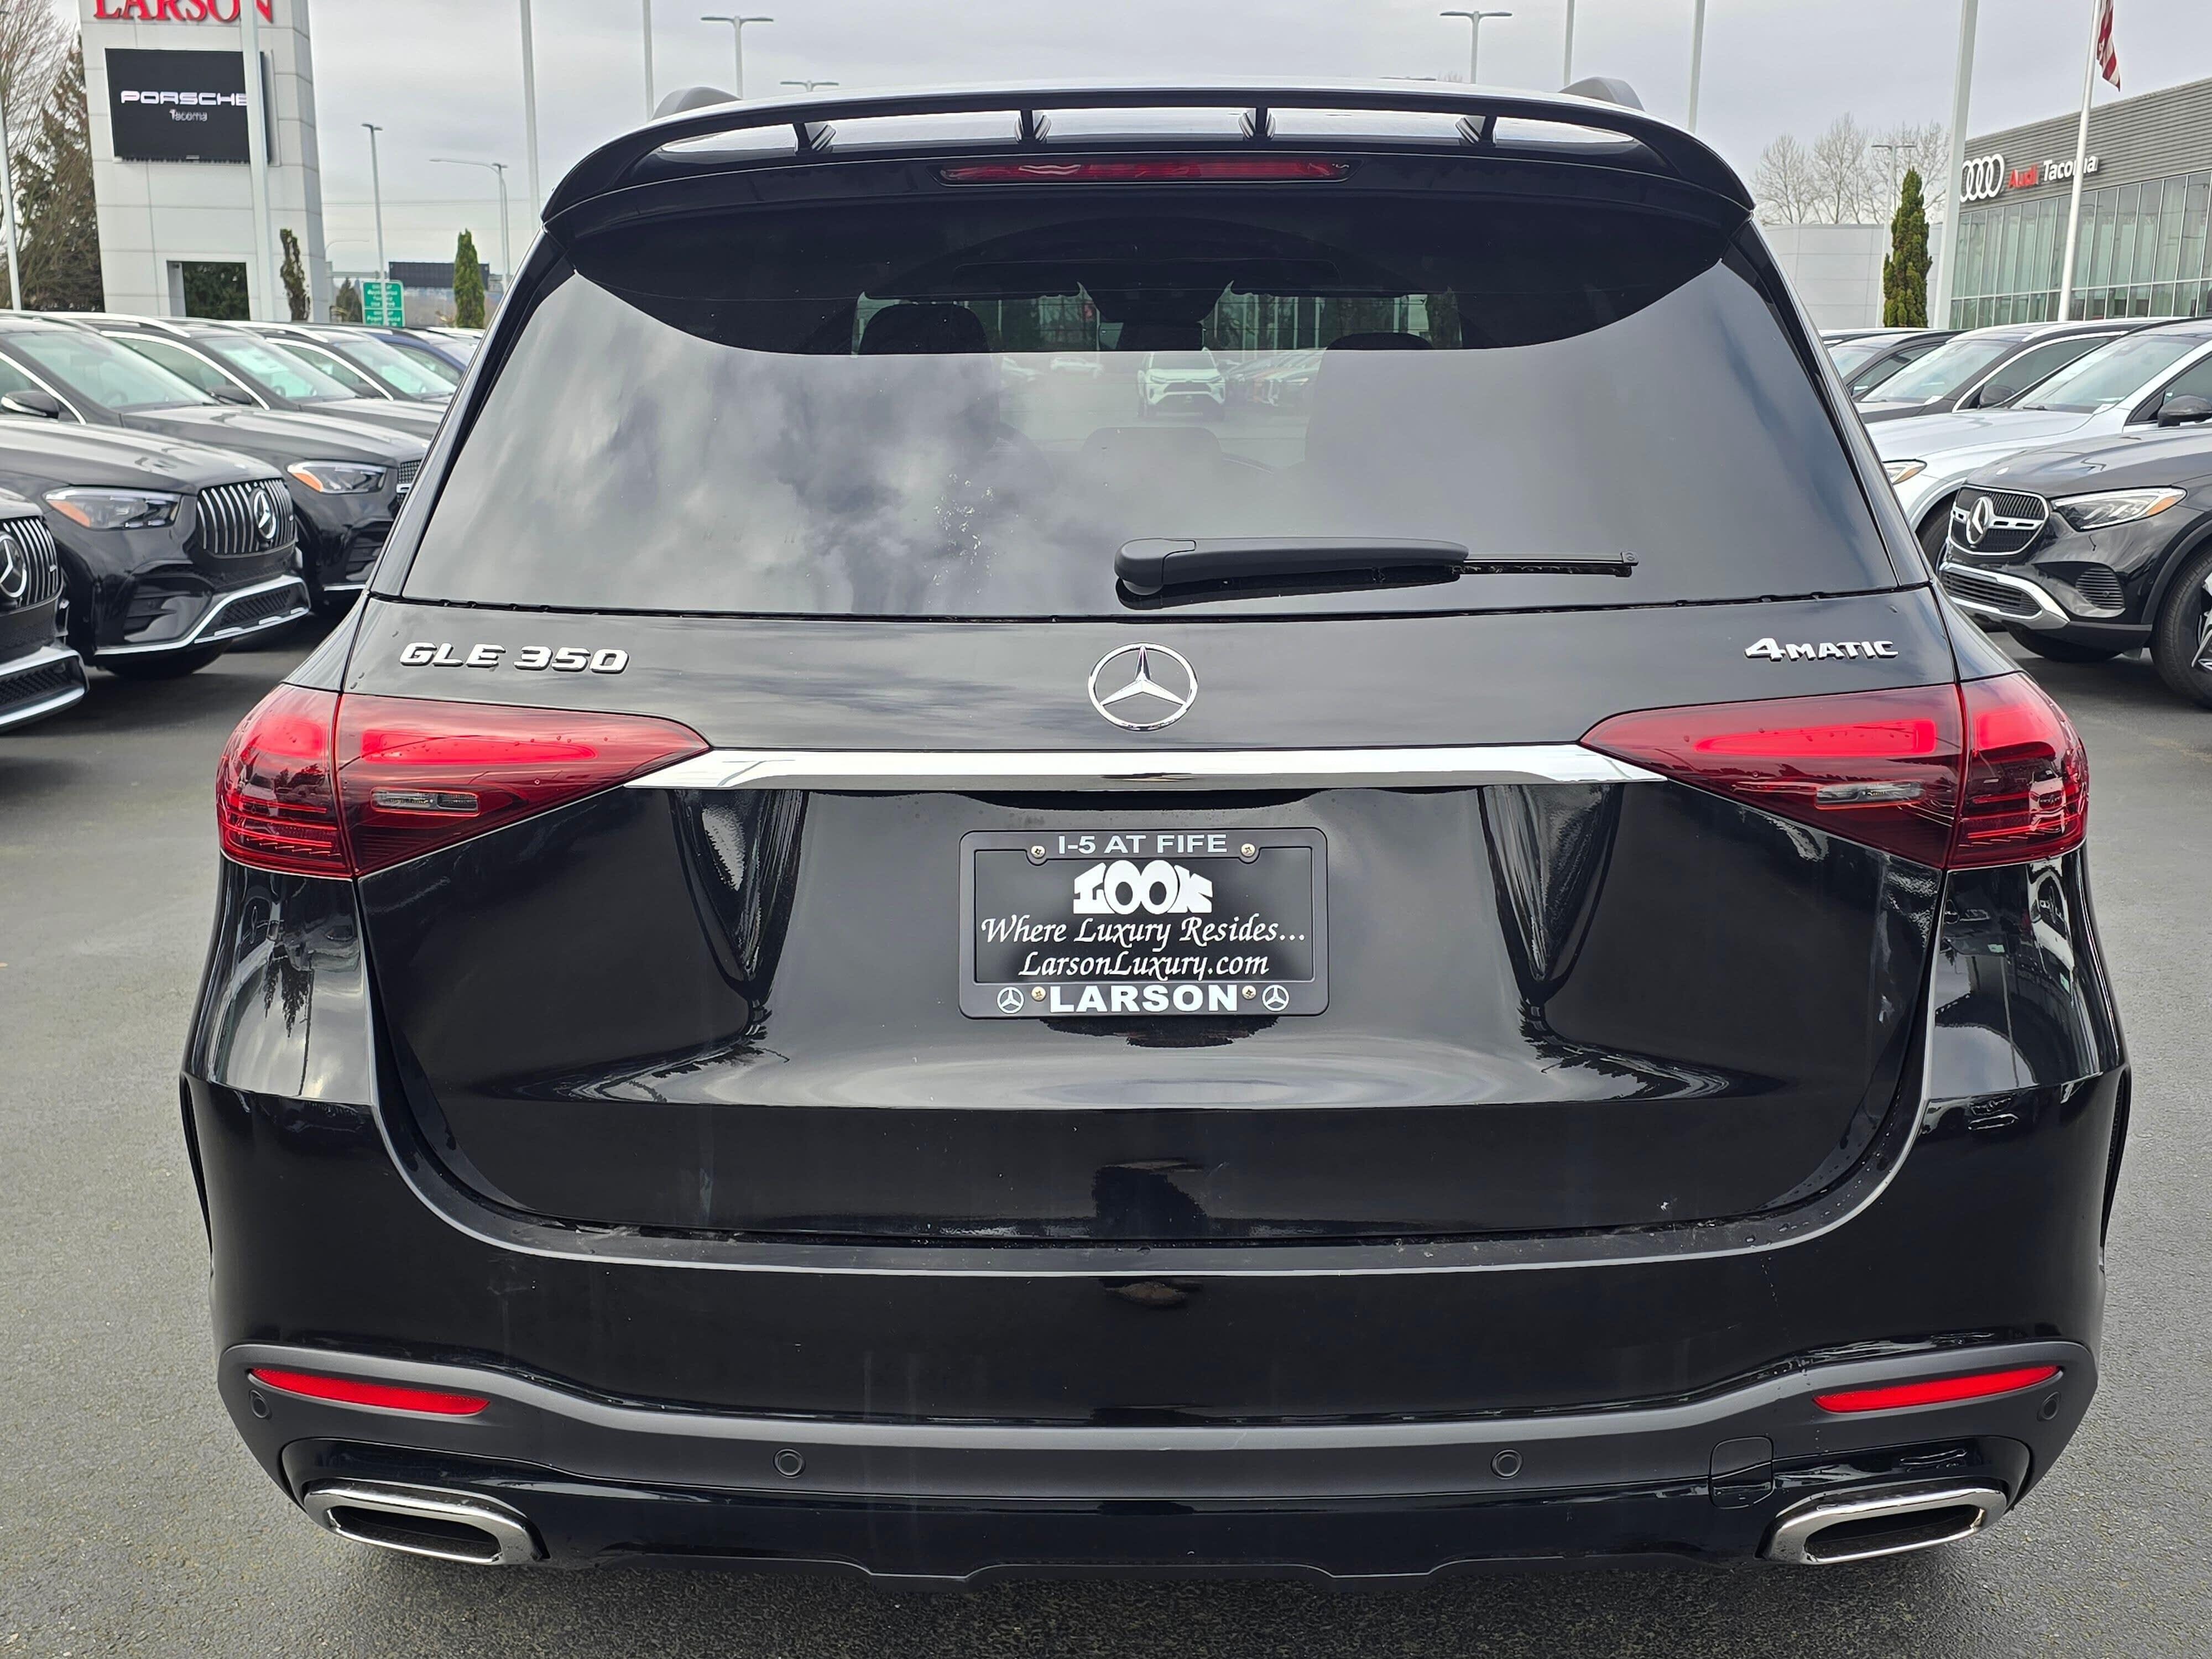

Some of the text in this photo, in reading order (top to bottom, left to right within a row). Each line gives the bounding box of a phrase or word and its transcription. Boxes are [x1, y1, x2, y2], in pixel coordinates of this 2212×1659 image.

[121, 90, 248, 106] PORSCHE
[2008, 164, 2038, 189] Audi
[399, 641, 629, 674] GLE 350
[1745, 638, 1899, 661] 4MATIC
[1058, 834, 1228, 854] I-5 AT FIFE
[981, 914, 1305, 952] Where Luxury Resides...
[1018, 951, 1270, 982] LarsonLuxury.com
[1050, 984, 1238, 1013] LARSON
